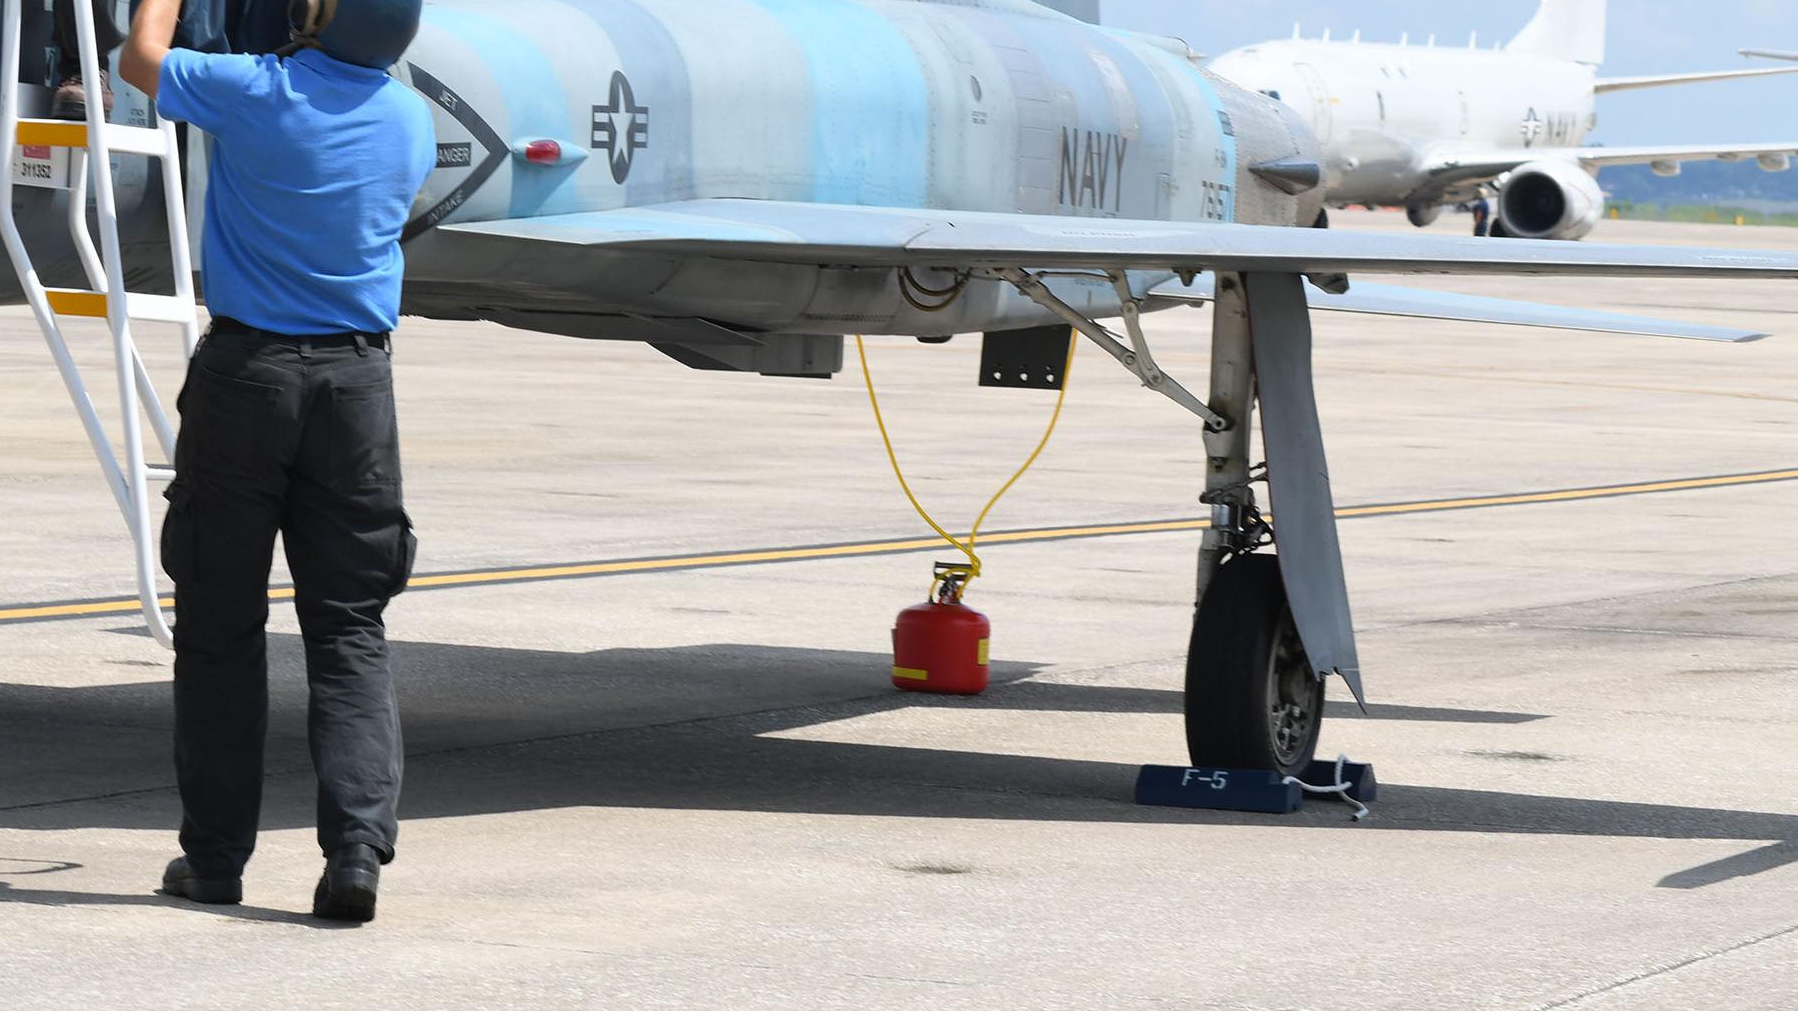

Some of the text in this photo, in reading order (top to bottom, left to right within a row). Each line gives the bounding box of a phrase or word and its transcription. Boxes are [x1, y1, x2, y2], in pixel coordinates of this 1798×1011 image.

[438, 89, 458, 110] JET
[437, 147, 470, 163] ANGER
[1059, 126, 1127, 212] NAVY
[1181, 769, 1229, 789] F-5
